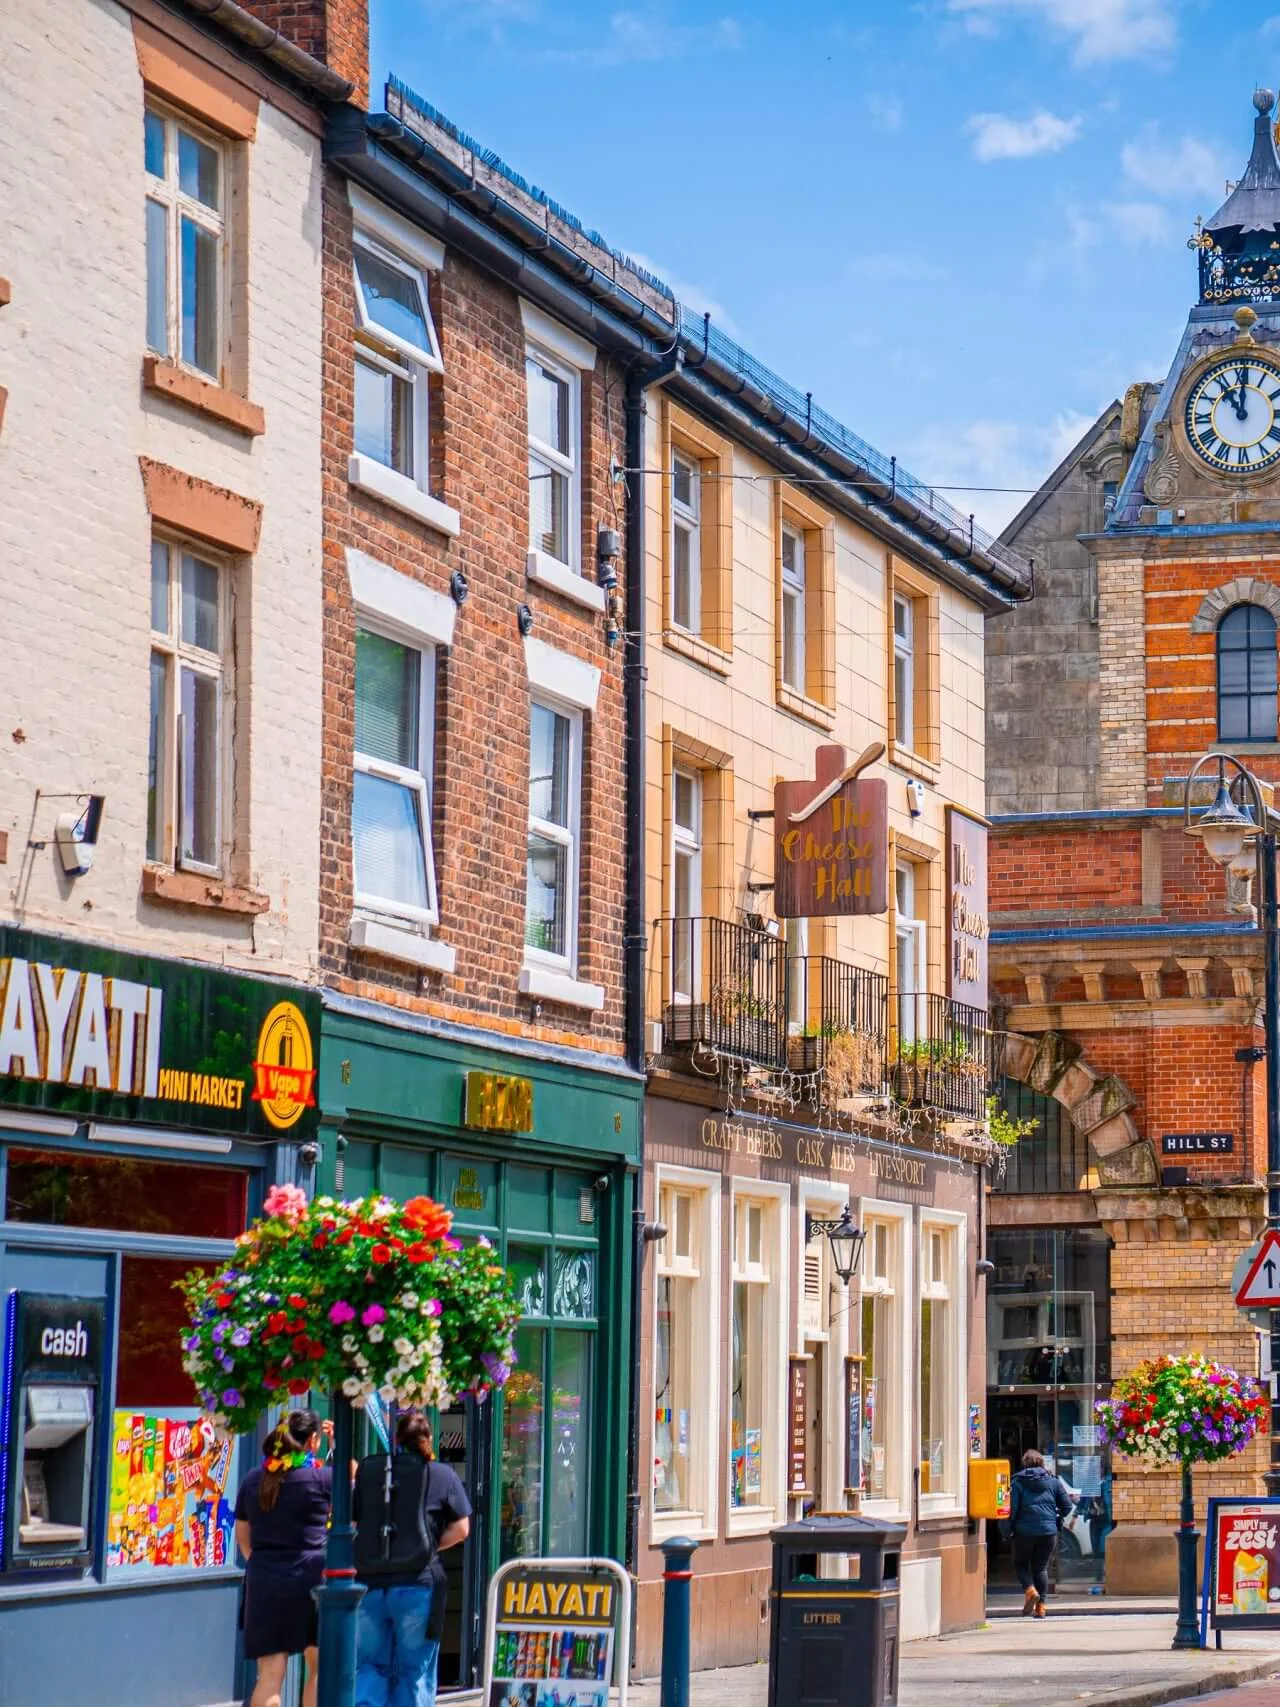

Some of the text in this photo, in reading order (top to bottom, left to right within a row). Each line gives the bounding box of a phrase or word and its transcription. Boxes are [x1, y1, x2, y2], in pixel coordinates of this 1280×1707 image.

[831, 795, 873, 833] The
[781, 829, 873, 863] Cheese
[813, 863, 873, 904] Hall
[158, 1069, 245, 1110] MINI MARKET
[269, 1070, 299, 1098] Vape
[702, 1118, 783, 1160] CRAFT BEERS
[796, 1137, 856, 1173] CASK ALES
[1167, 1138, 1205, 1149] HILL
[868, 1151, 926, 1186] LIVE SPORT
[41, 1320, 88, 1357] cash
[1224, 1524, 1279, 1551] zest
[1233, 1519, 1259, 1531] SIMPLY
[504, 1581, 613, 1617] HAYATI
[803, 1612, 841, 1625] LITTER
